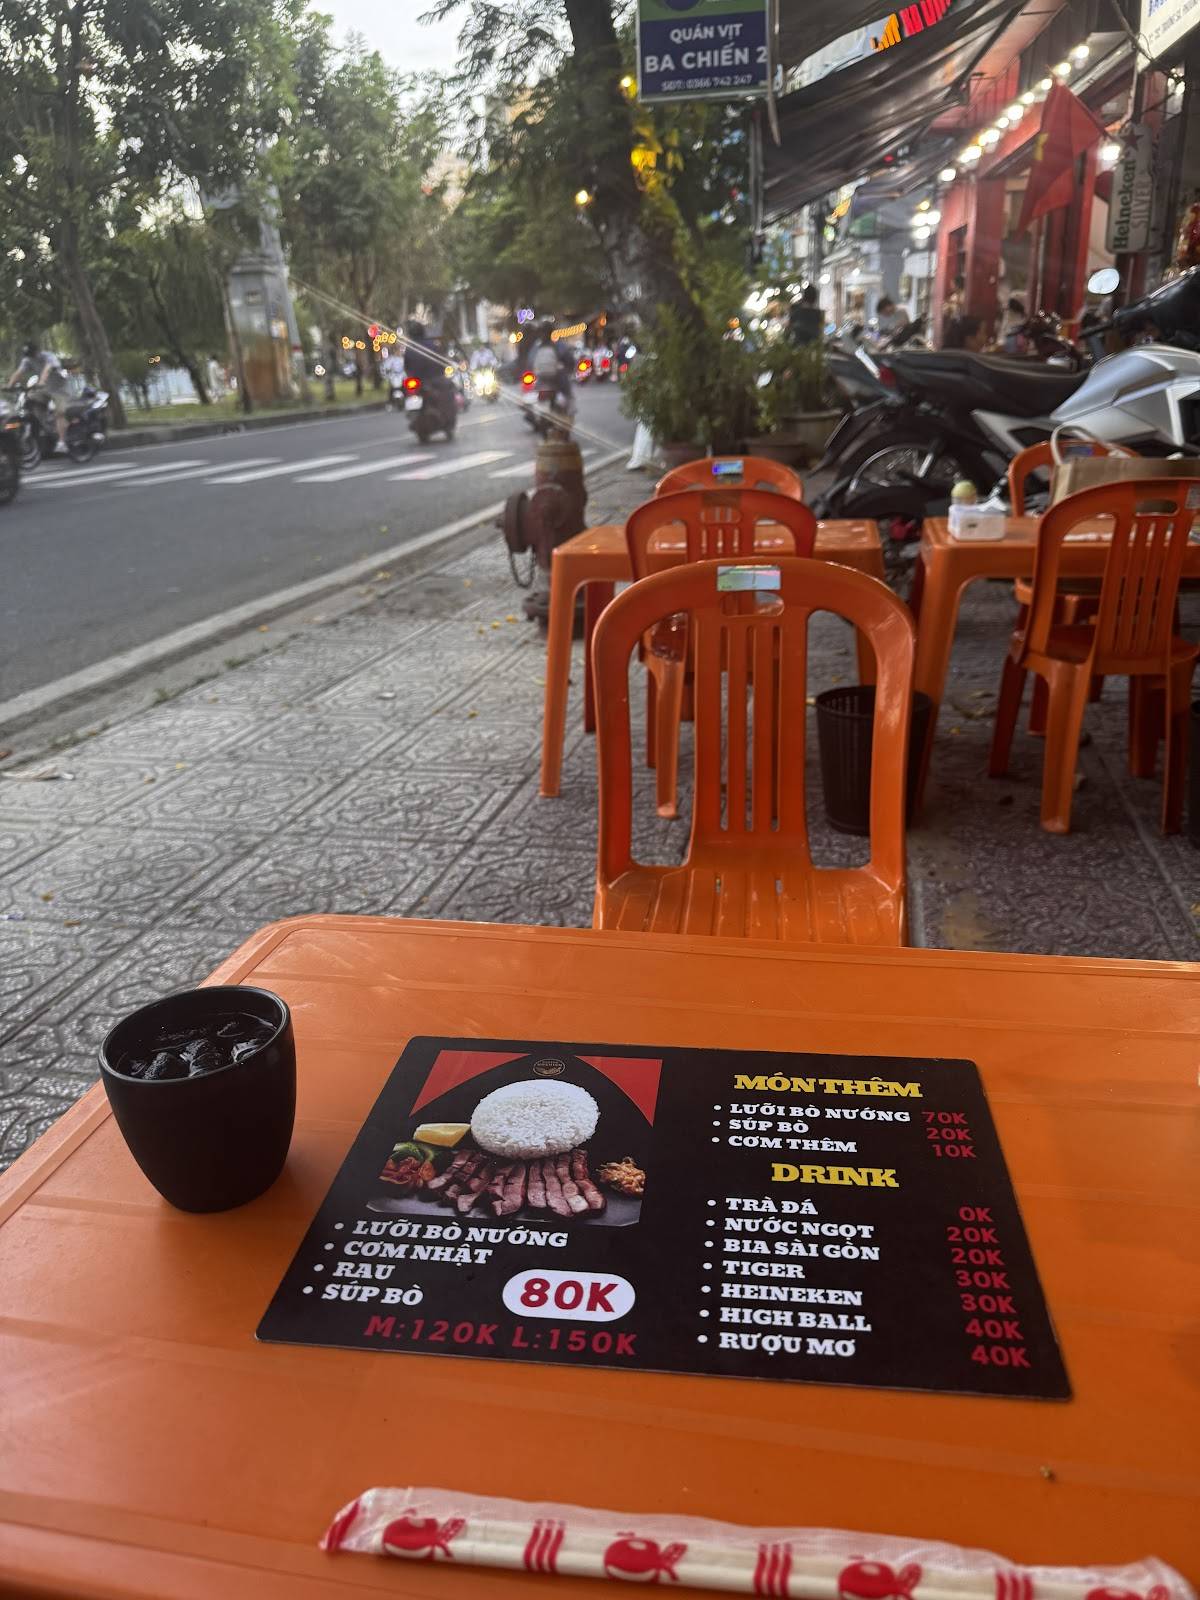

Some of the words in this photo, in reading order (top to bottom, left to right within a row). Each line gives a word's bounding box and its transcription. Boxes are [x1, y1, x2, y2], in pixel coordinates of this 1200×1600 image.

[670, 23, 715, 44] QUÁN
[717, 23, 743, 40] VỊT
[644, 54, 675, 73] BA
[681, 42, 749, 70] CHIẾN
[756, 46, 768, 63] 2
[1113, 157, 1136, 250] Heineken
[1130, 171, 1151, 230] SILVER
[734, 1071, 817, 1093] MÓN
[818, 1077, 924, 1098] THÊM
[729, 1102, 786, 1116] LƯỠI
[789, 1105, 820, 1118] BÒ
[825, 1106, 911, 1122] NƯỚNG
[922, 1111, 968, 1125] 70K
[729, 1117, 773, 1131] SÚP
[777, 1119, 809, 1134] BÒ
[927, 1127, 974, 1141] 20K
[728, 1135, 783, 1149] CƠM
[786, 1137, 858, 1153] THÊM
[932, 1143, 977, 1158] 10K
[771, 1162, 899, 1188] DRINK
[726, 1197, 779, 1213] TRÀ
[781, 1199, 818, 1216] ĐÁ
[959, 1206, 993, 1223] 0K
[352, 1219, 421, 1240] LƯỠI
[422, 1220, 465, 1242] BÒ
[465, 1224, 569, 1249] NƯỚNG
[724, 1215, 797, 1236] NƯỚC
[801, 1221, 874, 1241] NGỌT
[947, 1226, 1000, 1244] 20K
[343, 1240, 410, 1259] CƠM
[411, 1244, 493, 1267] NHẬT
[723, 1238, 771, 1254] BIA
[774, 1239, 819, 1257] SÀI
[822, 1243, 880, 1261] GÒN
[951, 1248, 1005, 1267] 20K
[332, 1261, 396, 1281] RAU
[722, 1260, 805, 1279] TIGER
[955, 1270, 1011, 1290] 30K
[321, 1281, 380, 1304] SÚP
[380, 1284, 424, 1307] BÒ
[519, 1276, 620, 1314] 80K
[720, 1282, 863, 1306] HEINEKEN
[960, 1294, 1017, 1315] 30K
[363, 1315, 500, 1346] M:120K
[511, 1325, 639, 1356] L:150K
[719, 1306, 794, 1326] HIGH
[797, 1311, 872, 1332] BALL
[964, 1318, 1025, 1341] 40K
[719, 1331, 803, 1356] RƯỢU
[806, 1337, 857, 1358] MƠ
[970, 1345, 1032, 1369] 40K
